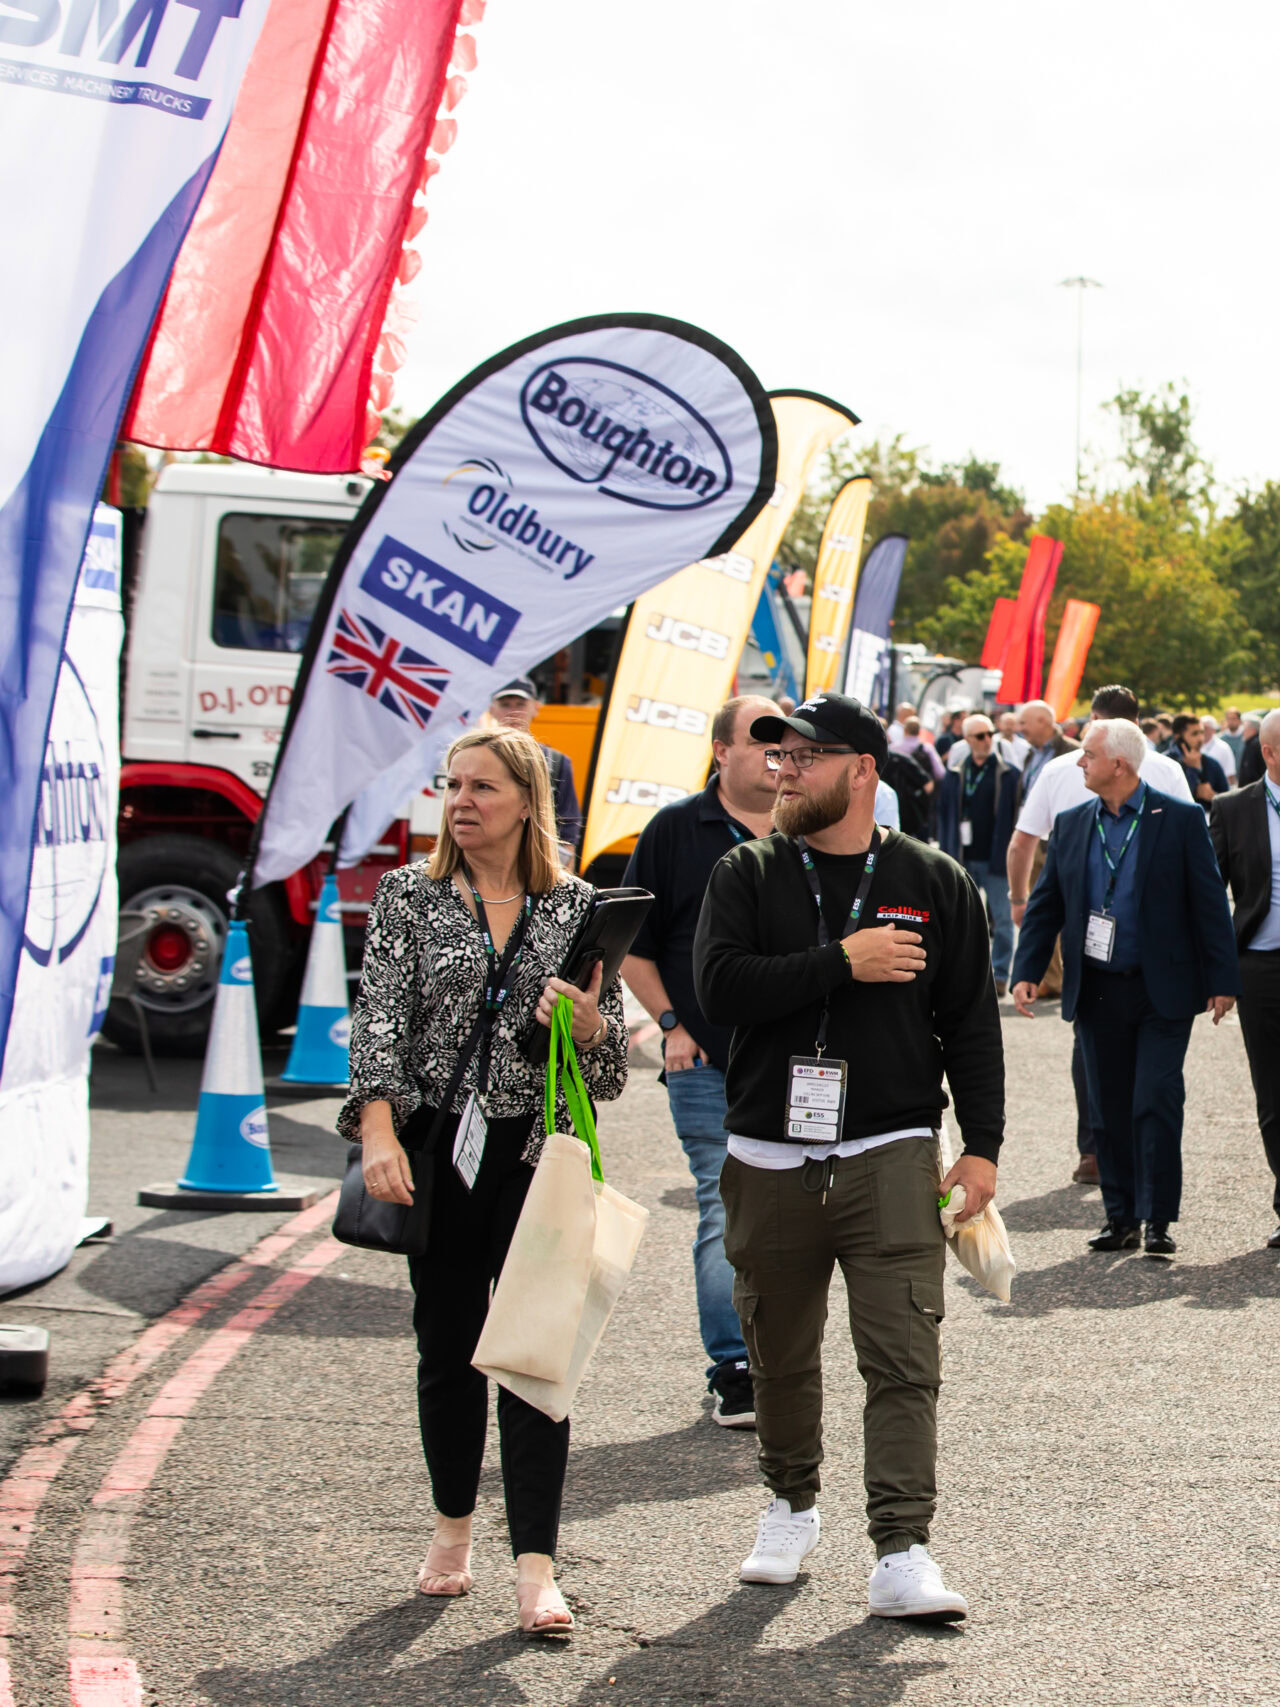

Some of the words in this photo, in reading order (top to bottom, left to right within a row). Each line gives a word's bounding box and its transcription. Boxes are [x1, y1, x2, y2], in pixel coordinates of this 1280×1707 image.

[138, 86, 193, 112] TRUCKS
[529, 370, 717, 497] Boughton
[468, 484, 595, 580] Oldbury
[381, 557, 501, 642] SKAN
[646, 613, 732, 661] JCB
[626, 695, 709, 736] JCB
[866, 853, 875, 865] ESS
[853, 898, 861, 911] ESS
[878, 905, 930, 917] Collins
[496, 988, 507, 1002] ESS
